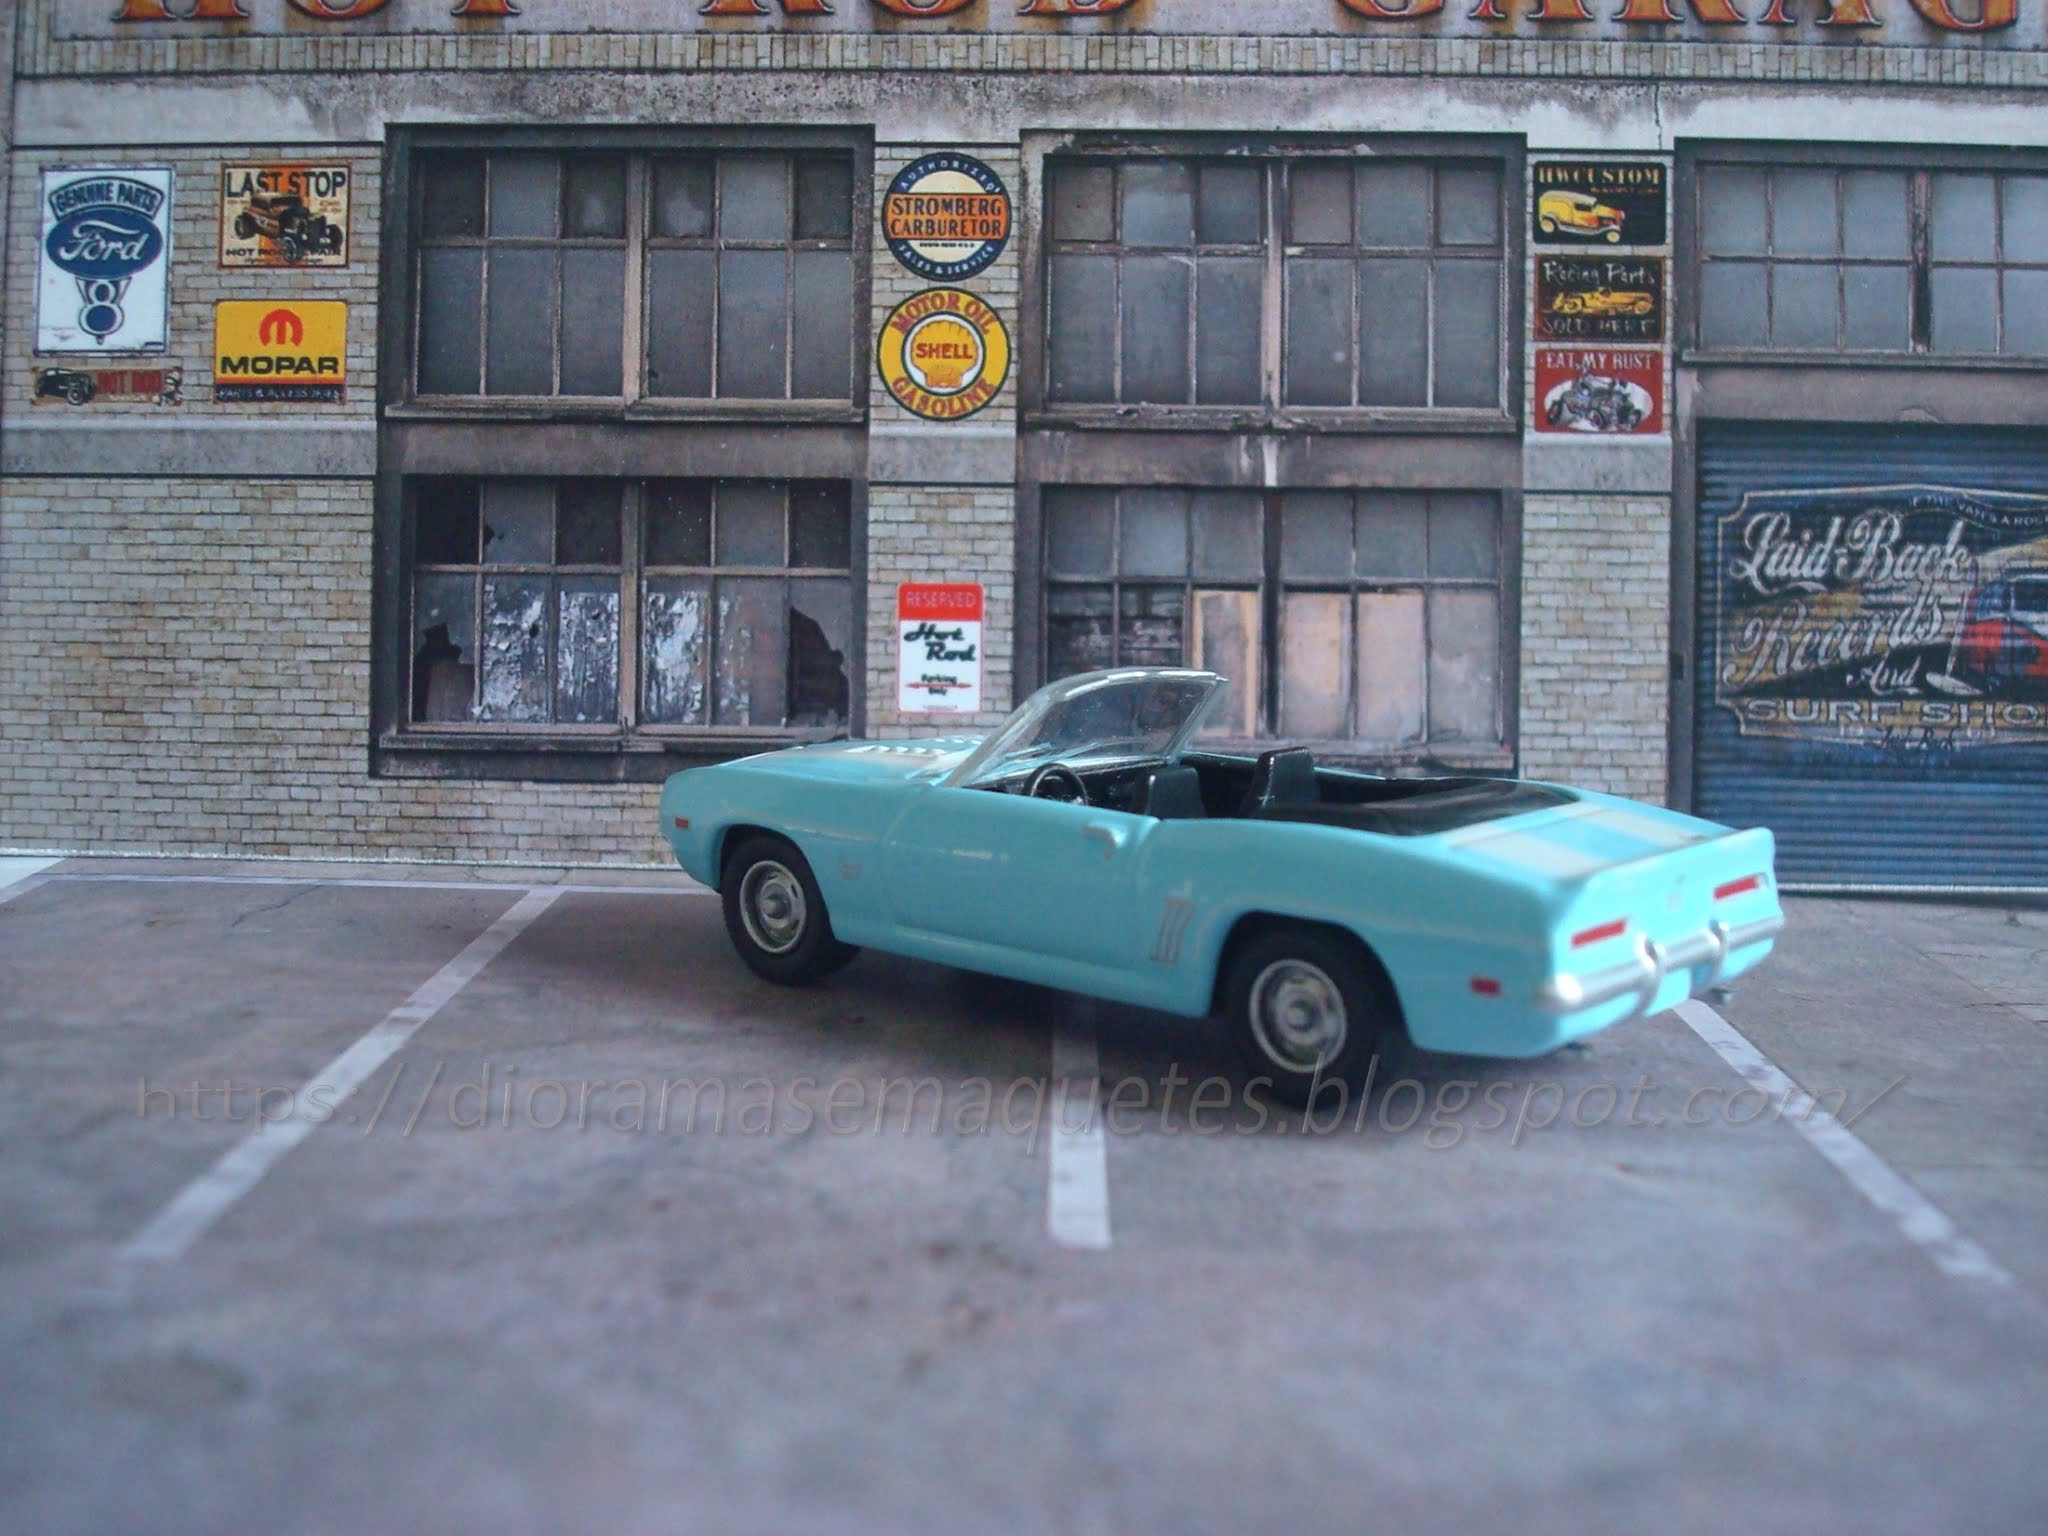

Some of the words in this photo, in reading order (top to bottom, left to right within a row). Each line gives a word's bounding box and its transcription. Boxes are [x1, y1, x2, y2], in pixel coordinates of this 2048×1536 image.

[226, 171, 282, 198] LAST
[287, 171, 346, 198] STOP
[901, 160, 997, 191] AUTHORIZED
[56, 182, 115, 213] GENUINE
[117, 183, 158, 212] PARTS
[891, 198, 1002, 217] STROMBERG
[890, 219, 1002, 237] CARBURETOR
[60, 220, 149, 261] Ford
[890, 292, 960, 335] MOTOR
[964, 300, 998, 335] OIL
[916, 343, 973, 359] SHELL
[1546, 351, 1574, 369] EAT
[1582, 351, 1607, 369] MY
[1612, 351, 1656, 370] RUST
[221, 356, 339, 374] MOPAR
[892, 377, 997, 417] GASOLINE
[905, 591, 977, 608] RESERVED
[903, 621, 965, 642] Hot
[925, 641, 976, 661] Rod
[1748, 701, 1902, 723] SURF
